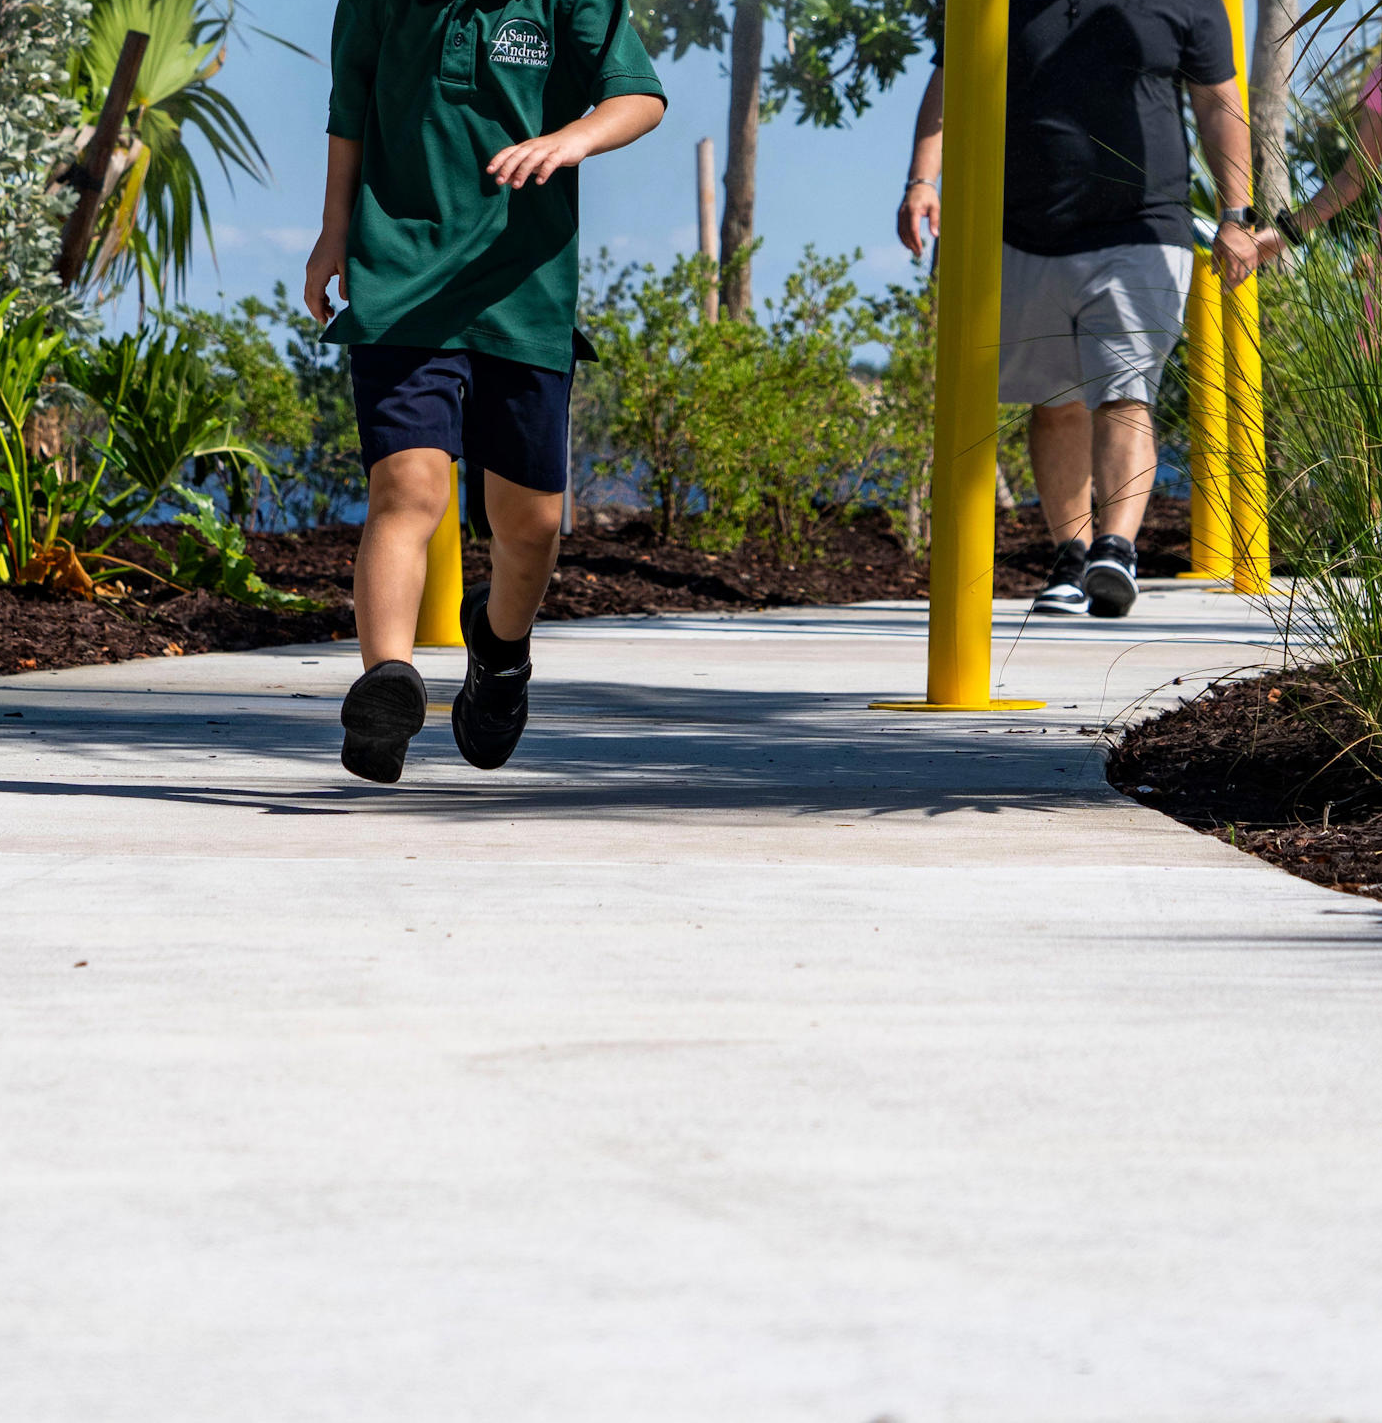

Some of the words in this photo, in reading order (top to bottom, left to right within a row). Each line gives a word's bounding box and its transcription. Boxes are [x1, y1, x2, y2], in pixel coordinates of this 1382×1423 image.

[508, 29, 538, 44] Saint
[491, 30, 548, 59] Andrew
[489, 54, 522, 64] CATHOLIC
[523, 57, 549, 67] SCHOOL
